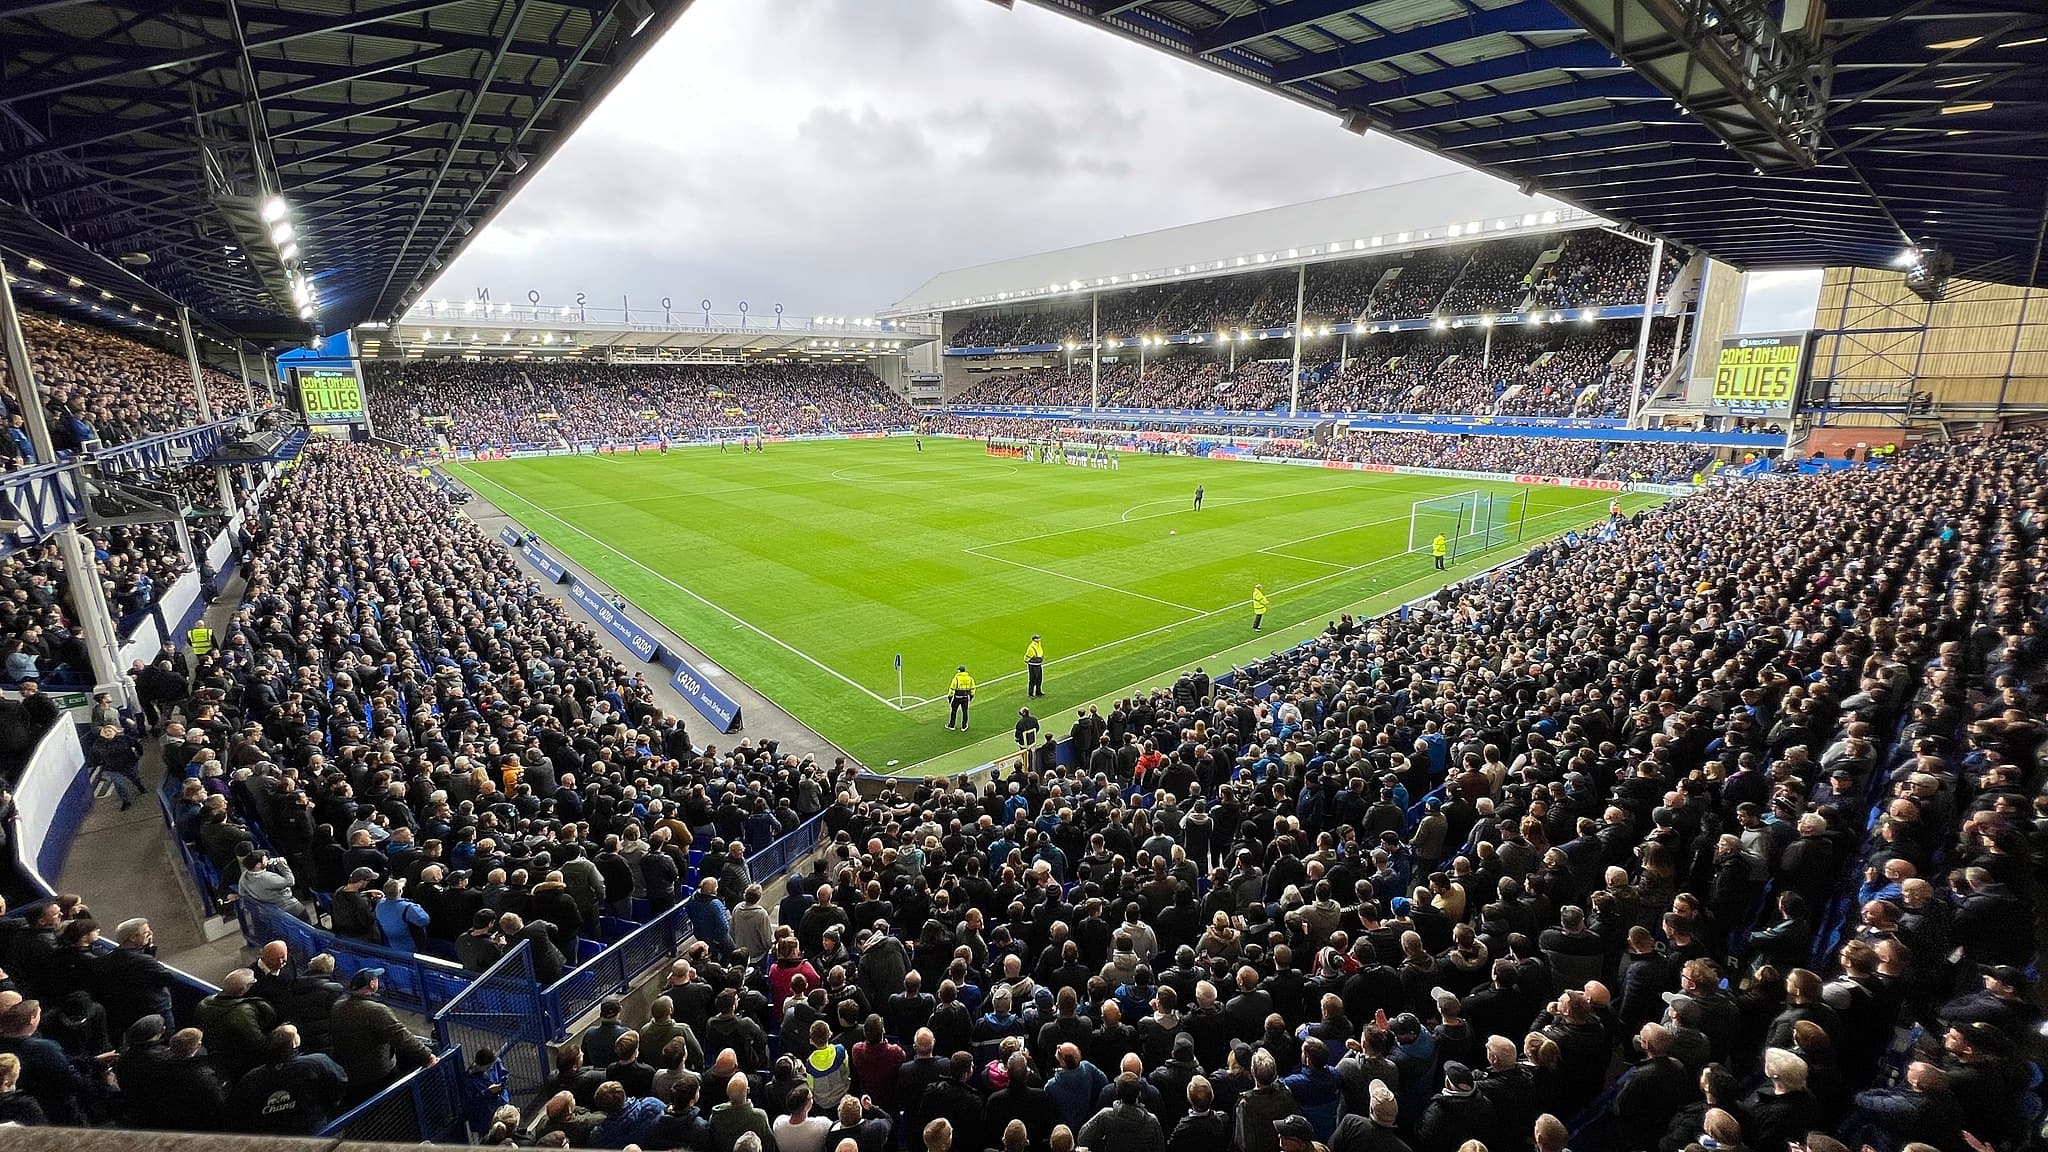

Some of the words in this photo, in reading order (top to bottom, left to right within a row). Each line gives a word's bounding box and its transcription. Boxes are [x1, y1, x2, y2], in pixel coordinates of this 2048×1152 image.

[1720, 347, 1752, 365] COME
[1752, 347, 1770, 364] ON
[1769, 345, 1799, 364] YOU
[301, 377, 328, 389] COME
[327, 377, 340, 389] ON
[340, 377, 357, 389] YOU
[1716, 366, 1791, 397] BLUES
[305, 390, 359, 411] BLUES
[1322, 461, 1354, 470] CAZOO
[1361, 464, 1395, 473] CAZOO
[1570, 480, 1620, 490] CAZOO
[632, 635, 652, 655] CAZOO
[677, 671, 701, 696] CAZOO
[262, 1100, 296, 1115] Chang
